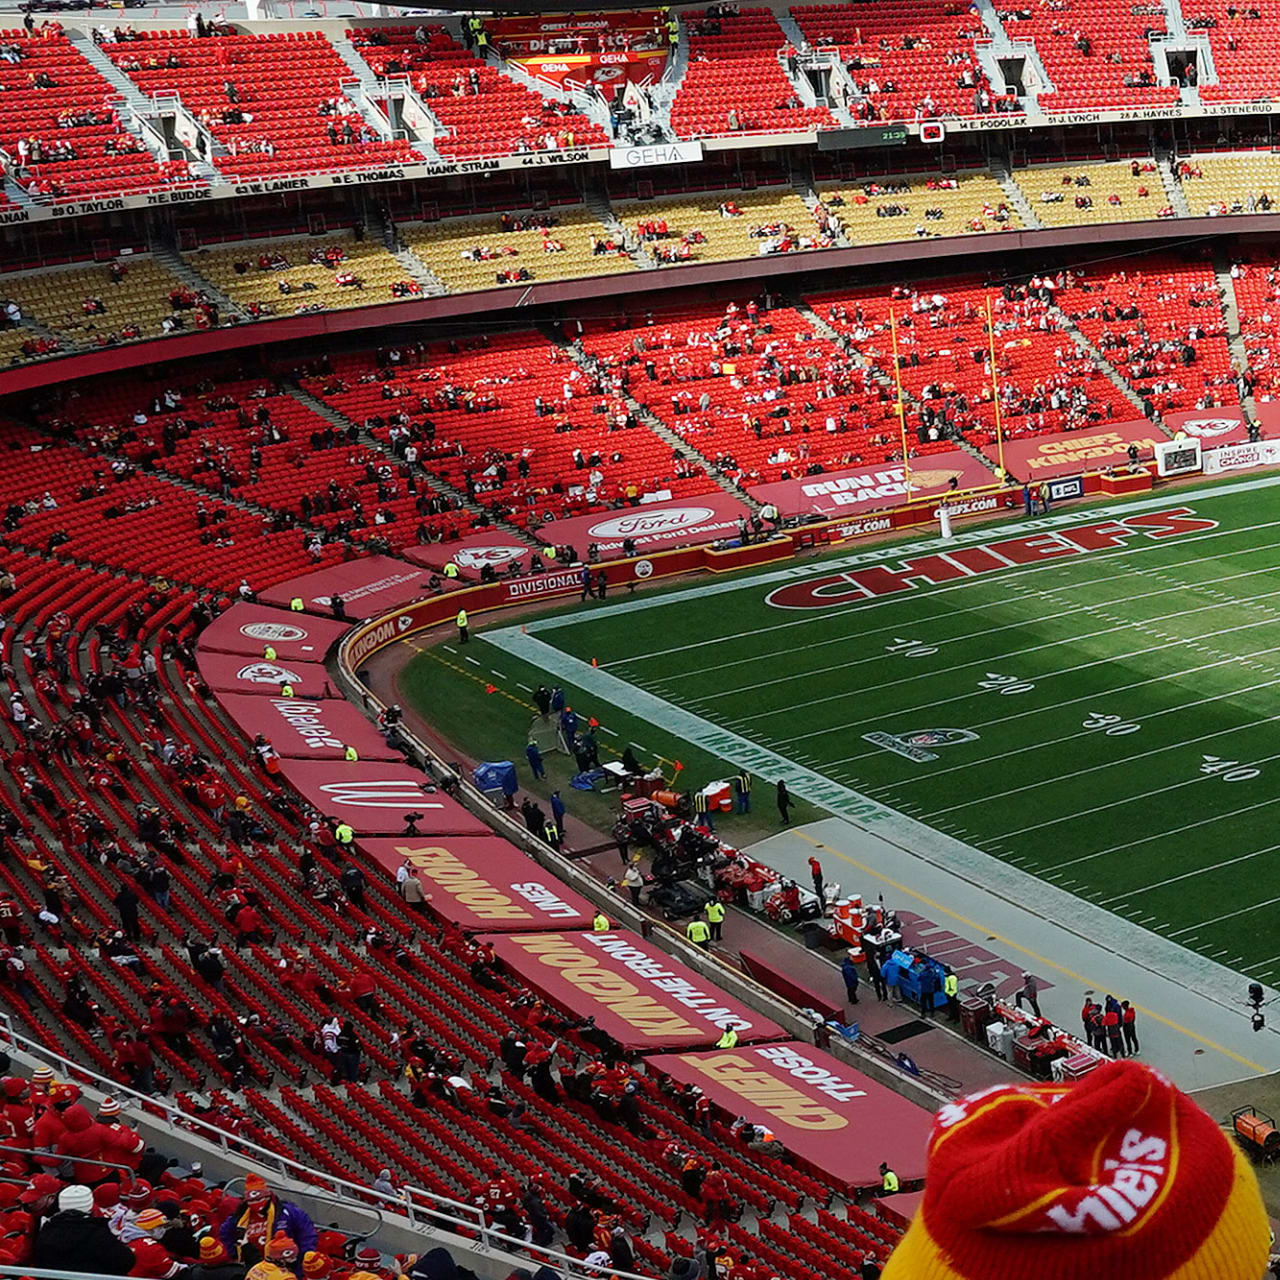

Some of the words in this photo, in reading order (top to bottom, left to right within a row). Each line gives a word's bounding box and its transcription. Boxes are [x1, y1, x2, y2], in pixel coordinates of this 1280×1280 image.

[1143, 109, 1182, 118] HAYNES
[1220, 105, 1272, 113] STENERUD
[627, 146, 684, 165] GEHA
[427, 163, 458, 175] HANK
[462, 161, 499, 172] STRAM
[265, 179, 309, 191] LANIER
[80, 200, 124, 213] TAYLOR
[1027, 438, 1156, 469] KINGDOM
[1038, 431, 1122, 454] CHIEFS
[801, 474, 871, 499] RUN
[874, 468, 908, 485] IT
[830, 481, 920, 505] BACK
[618, 513, 688, 534] Ford
[655, 526, 688, 543] Ford
[764, 507, 1220, 611] CHIEFS
[509, 575, 582, 596] DIVISIONAL
[886, 638, 938, 658] 10
[978, 673, 1034, 695] 20
[1082, 712, 1140, 736] 30
[698, 732, 796, 776] INSPIRE
[785, 775, 894, 824] CHANGE
[1200, 755, 1260, 782] 40
[394, 846, 535, 919] HONORS
[510, 881, 581, 918] LINES
[581, 933, 676, 980] FRONT
[508, 934, 706, 1037] KINGDOM
[648, 976, 717, 1010] THE
[695, 1007, 753, 1032] ON
[754, 1046, 868, 1103] THOSE
[679, 1054, 849, 1131] CHIEFS
